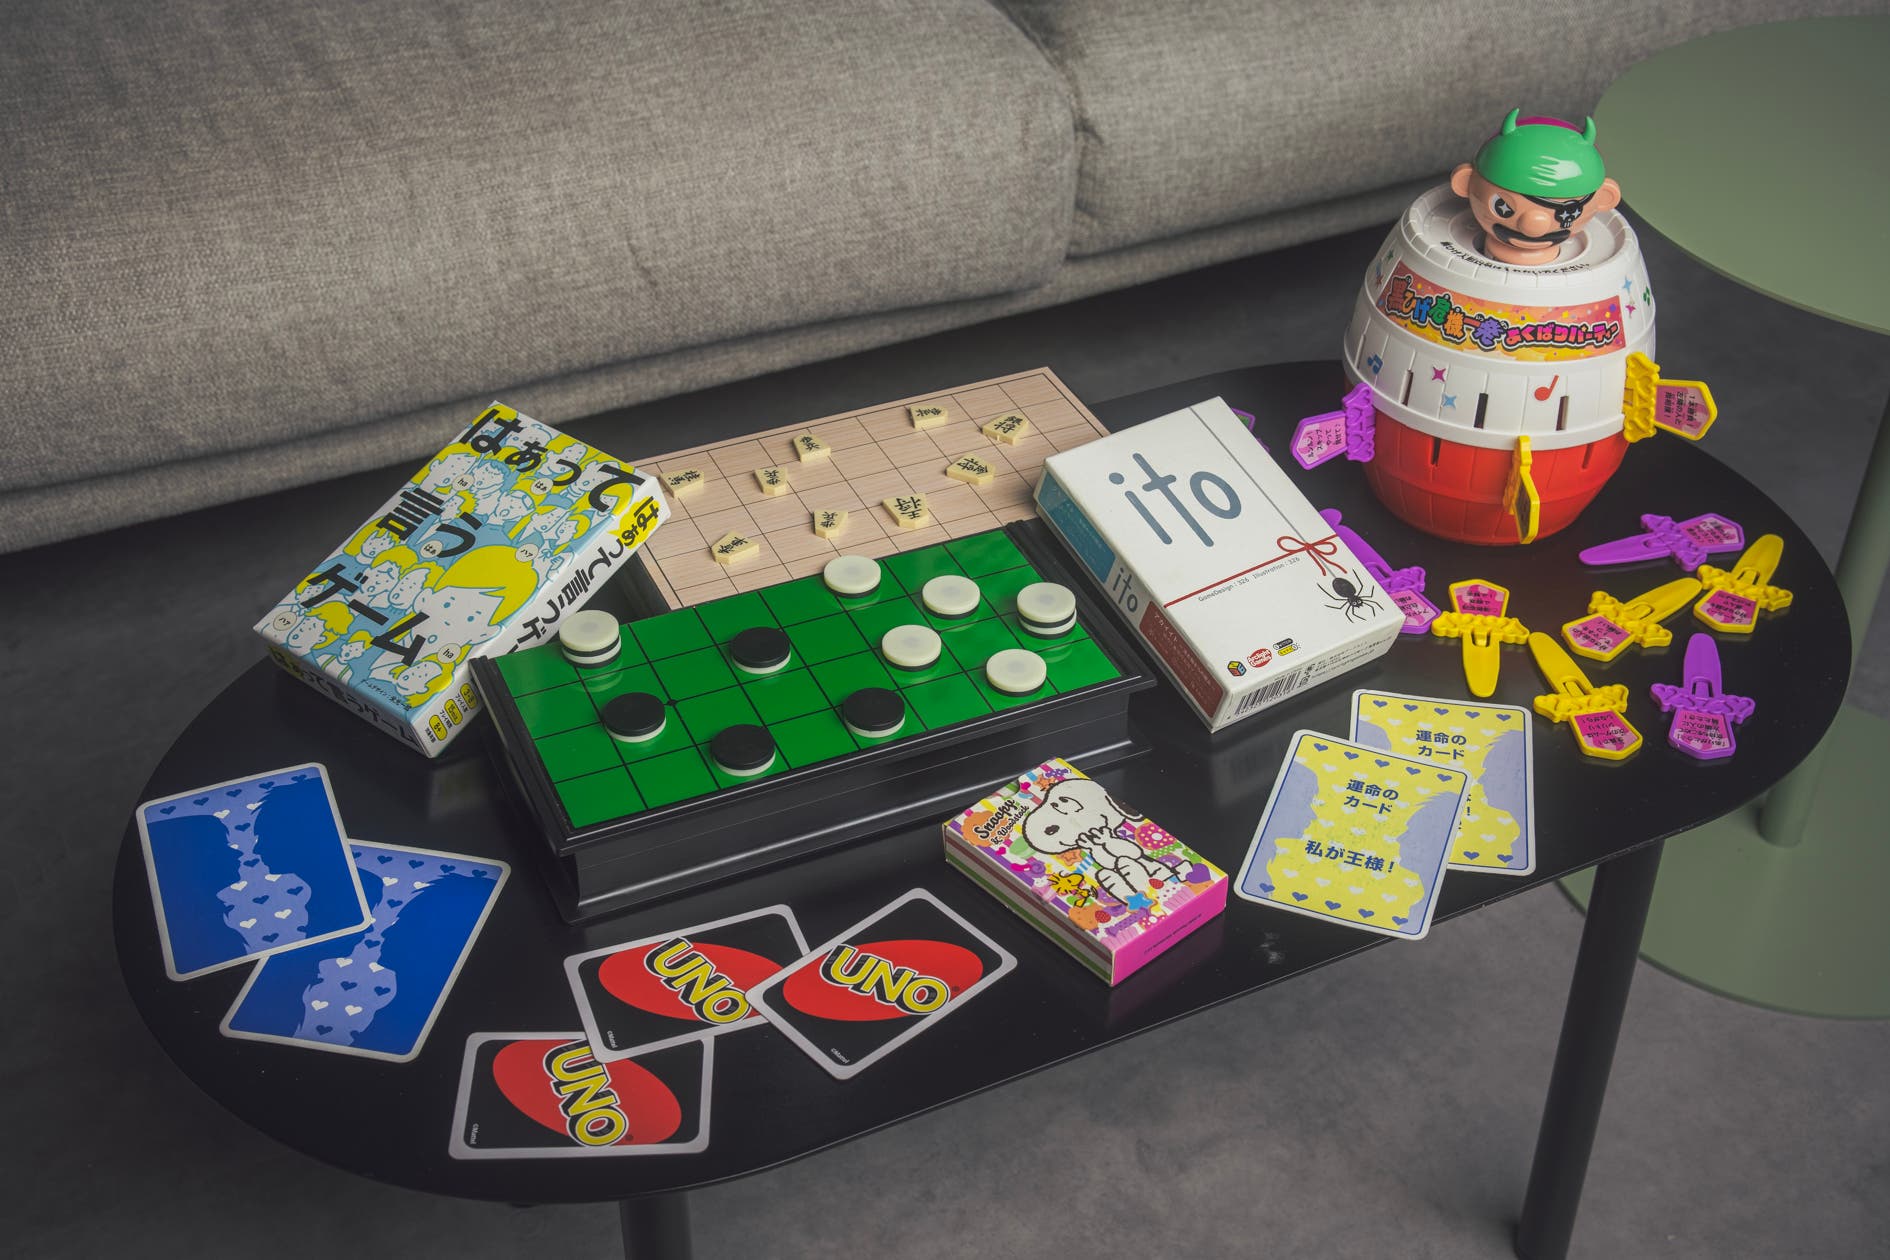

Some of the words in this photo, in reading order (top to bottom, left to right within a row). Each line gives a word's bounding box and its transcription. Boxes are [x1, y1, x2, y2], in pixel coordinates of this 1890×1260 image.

[460, 409, 646, 512] はぁって
[894, 496, 921, 520] 王将
[1108, 452, 1242, 547] ito
[375, 487, 483, 558] 言う
[1112, 567, 1138, 613] ito
[300, 563, 430, 666] ゲーム
[443, 648, 455, 658] ha
[1416, 729, 1467, 746] 運命の
[1418, 745, 1465, 760] カード
[1343, 795, 1393, 816] カード
[1346, 778, 1399, 801] 運命の
[974, 799, 1017, 838] Snoopy
[997, 805, 1030, 838] Woodstock
[1304, 840, 1396, 873] 私が王様！
[643, 937, 753, 1025] UNO
[820, 944, 950, 1016] UNO
[544, 1040, 629, 1148] UNO
